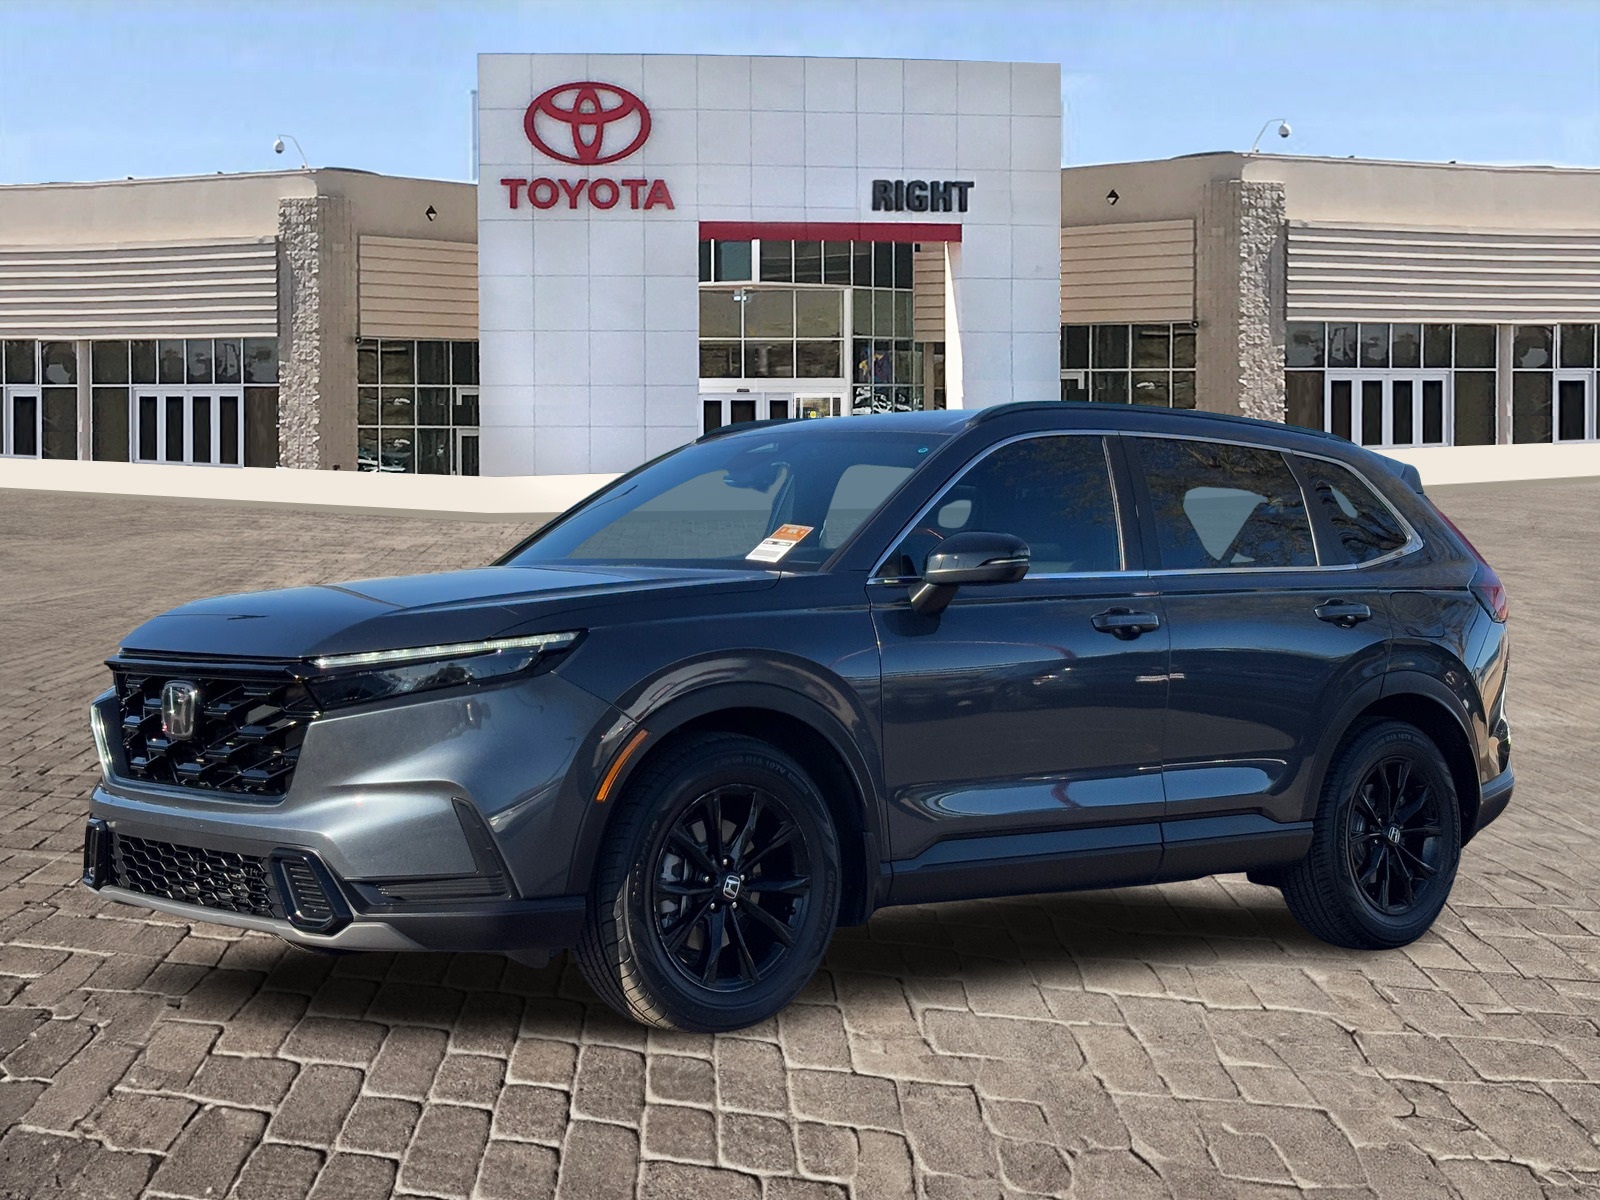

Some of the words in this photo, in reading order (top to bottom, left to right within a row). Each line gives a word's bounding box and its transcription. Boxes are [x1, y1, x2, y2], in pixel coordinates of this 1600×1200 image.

[500, 178, 675, 209] TOYOTA
[872, 179, 975, 212] RIGHT
[765, 759, 786, 775] 107V
